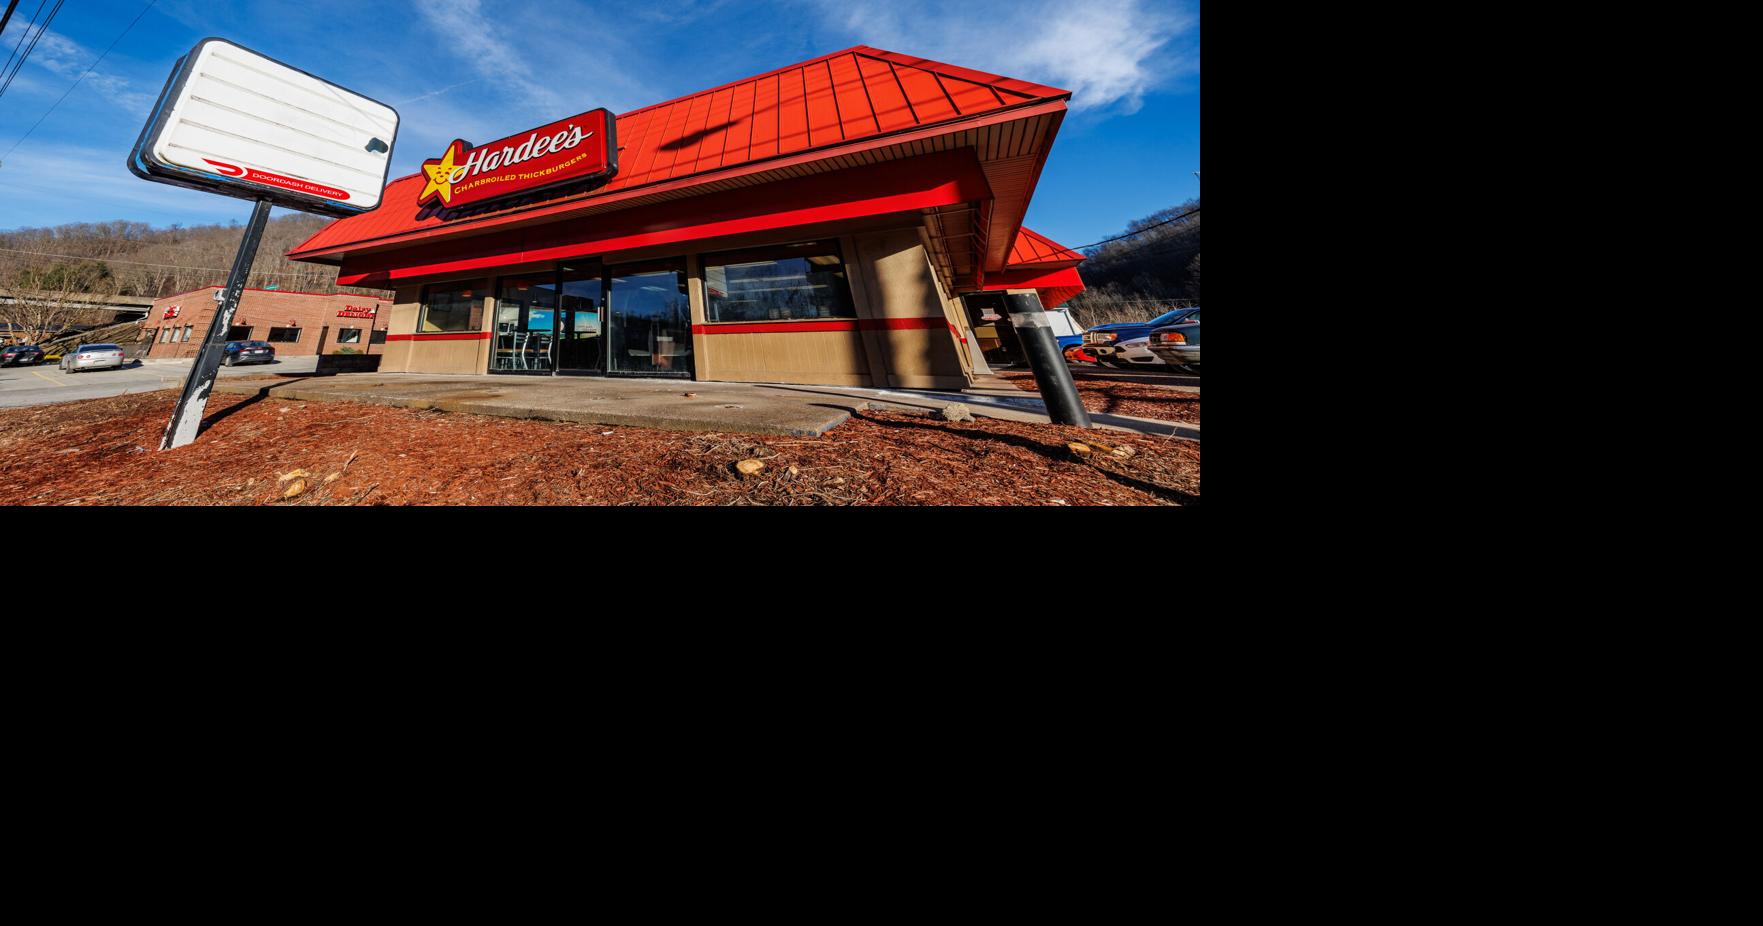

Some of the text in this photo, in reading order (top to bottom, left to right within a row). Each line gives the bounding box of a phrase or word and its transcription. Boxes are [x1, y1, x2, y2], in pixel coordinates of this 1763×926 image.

[448, 124, 593, 184] Hardee's
[454, 152, 587, 194] CHARBROILED THICKBURGERS
[252, 172, 343, 197] DOORDASH DELIVERY
